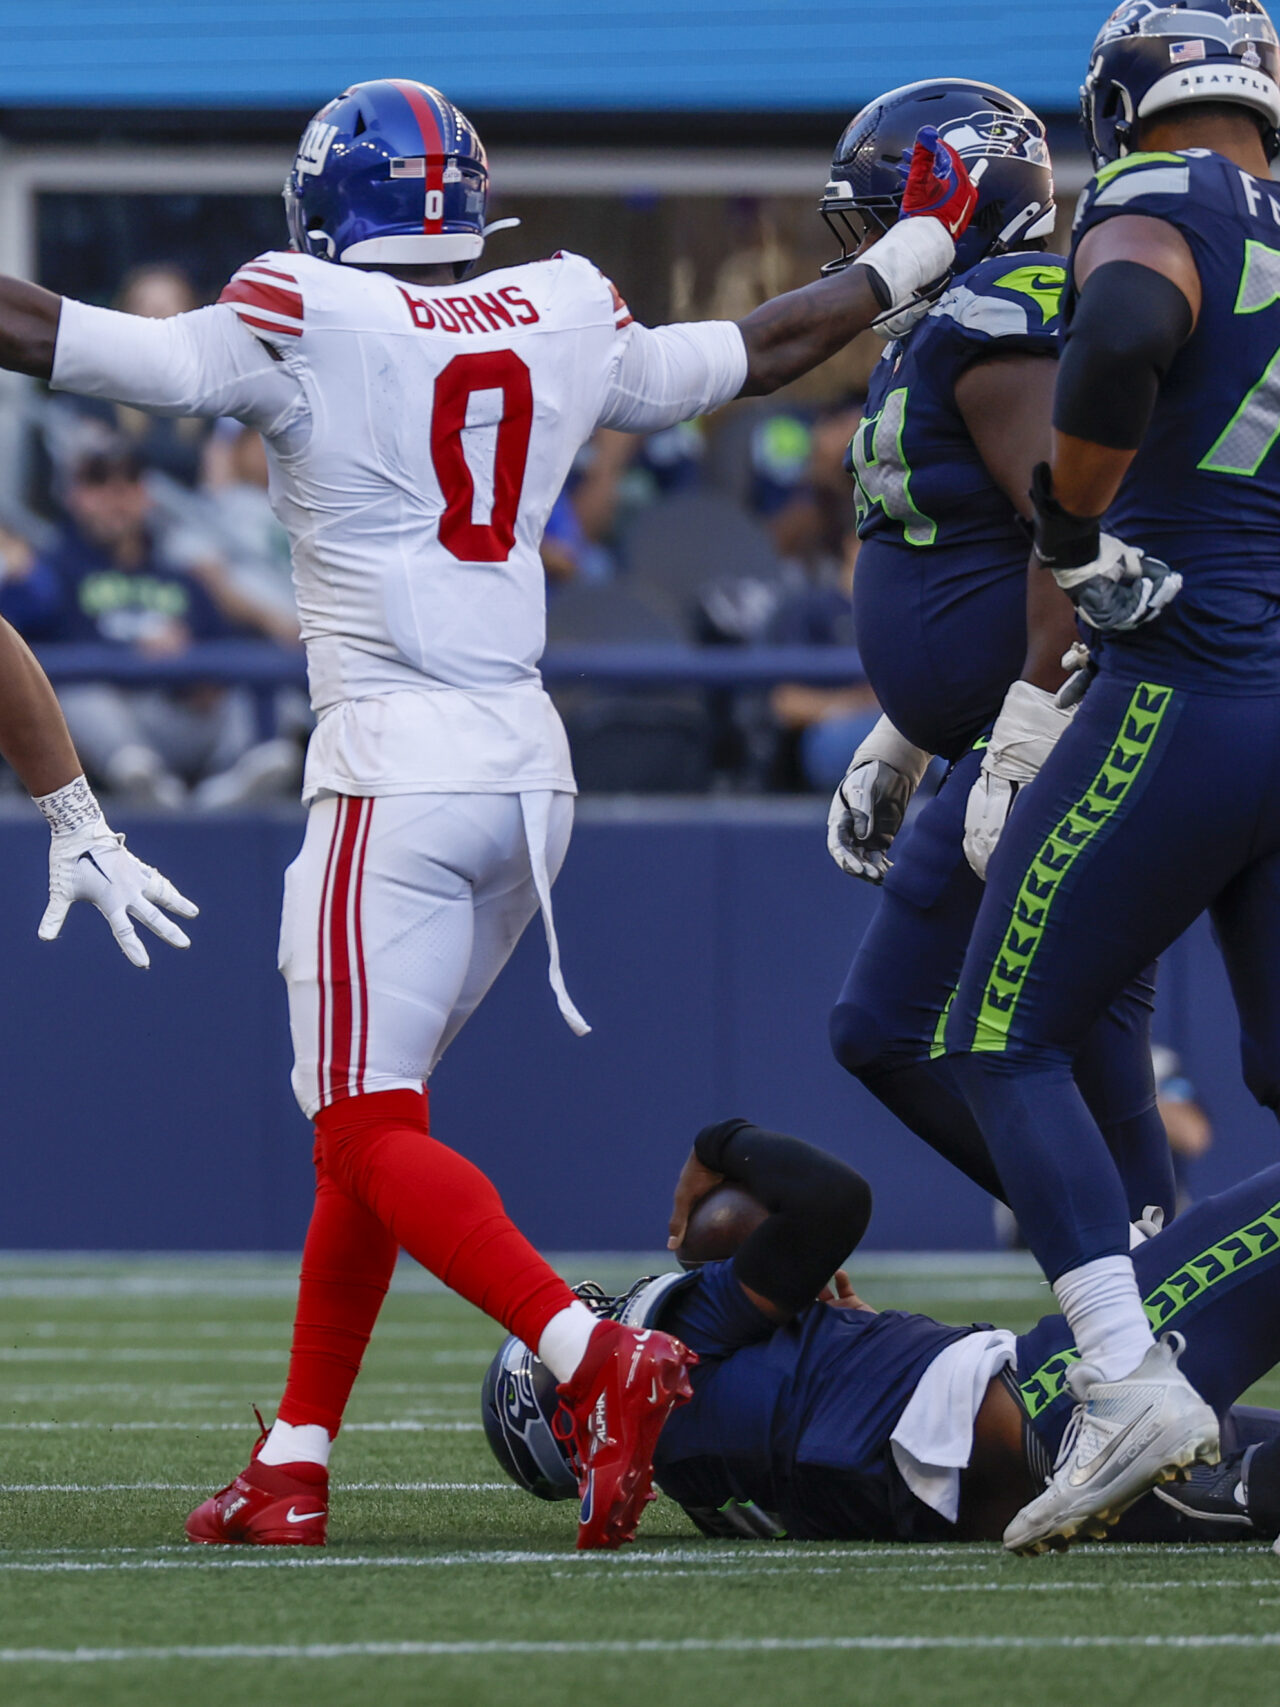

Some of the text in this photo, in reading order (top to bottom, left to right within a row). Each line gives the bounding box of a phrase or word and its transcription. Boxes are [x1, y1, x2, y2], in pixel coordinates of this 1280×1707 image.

[1179, 74, 1269, 94] SEATTLE
[425, 189, 443, 220] 0
[397, 285, 540, 334] BURNS
[430, 348, 534, 563] 0
[847, 387, 938, 546] 4
